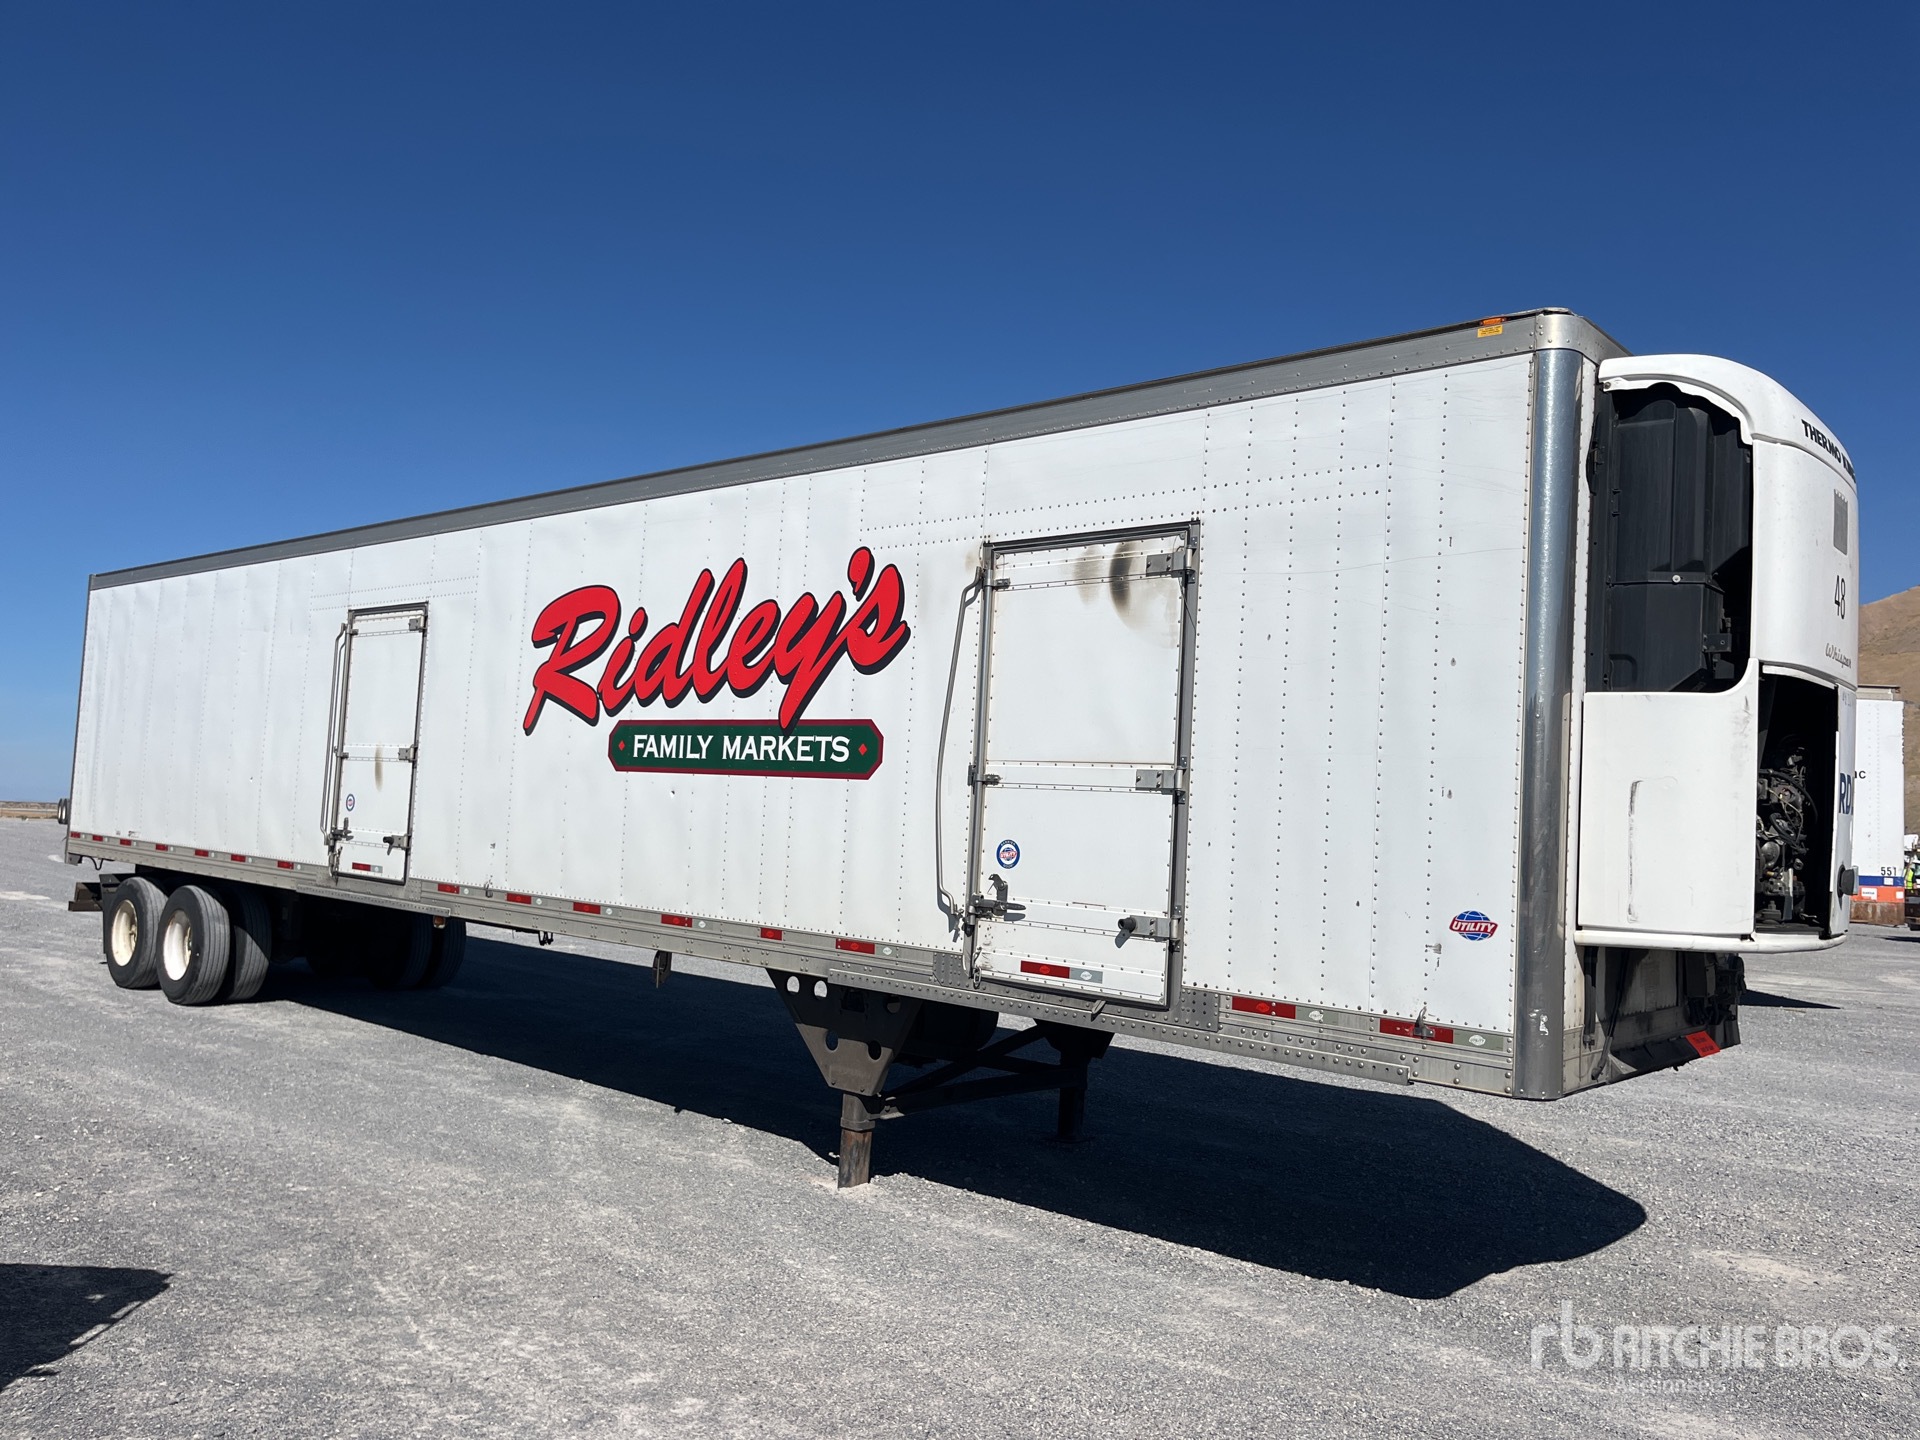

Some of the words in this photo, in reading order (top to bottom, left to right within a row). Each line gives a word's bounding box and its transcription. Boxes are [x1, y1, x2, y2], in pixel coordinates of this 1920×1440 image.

[1801, 419, 1841, 463] THERMO
[1834, 575, 1846, 620] 48
[523, 546, 911, 736] Ridley's
[633, 734, 713, 760] FAMILY
[722, 736, 850, 763] MARKETS
[1880, 866, 1897, 876] 551
[1452, 920, 1496, 932] UTILITY
